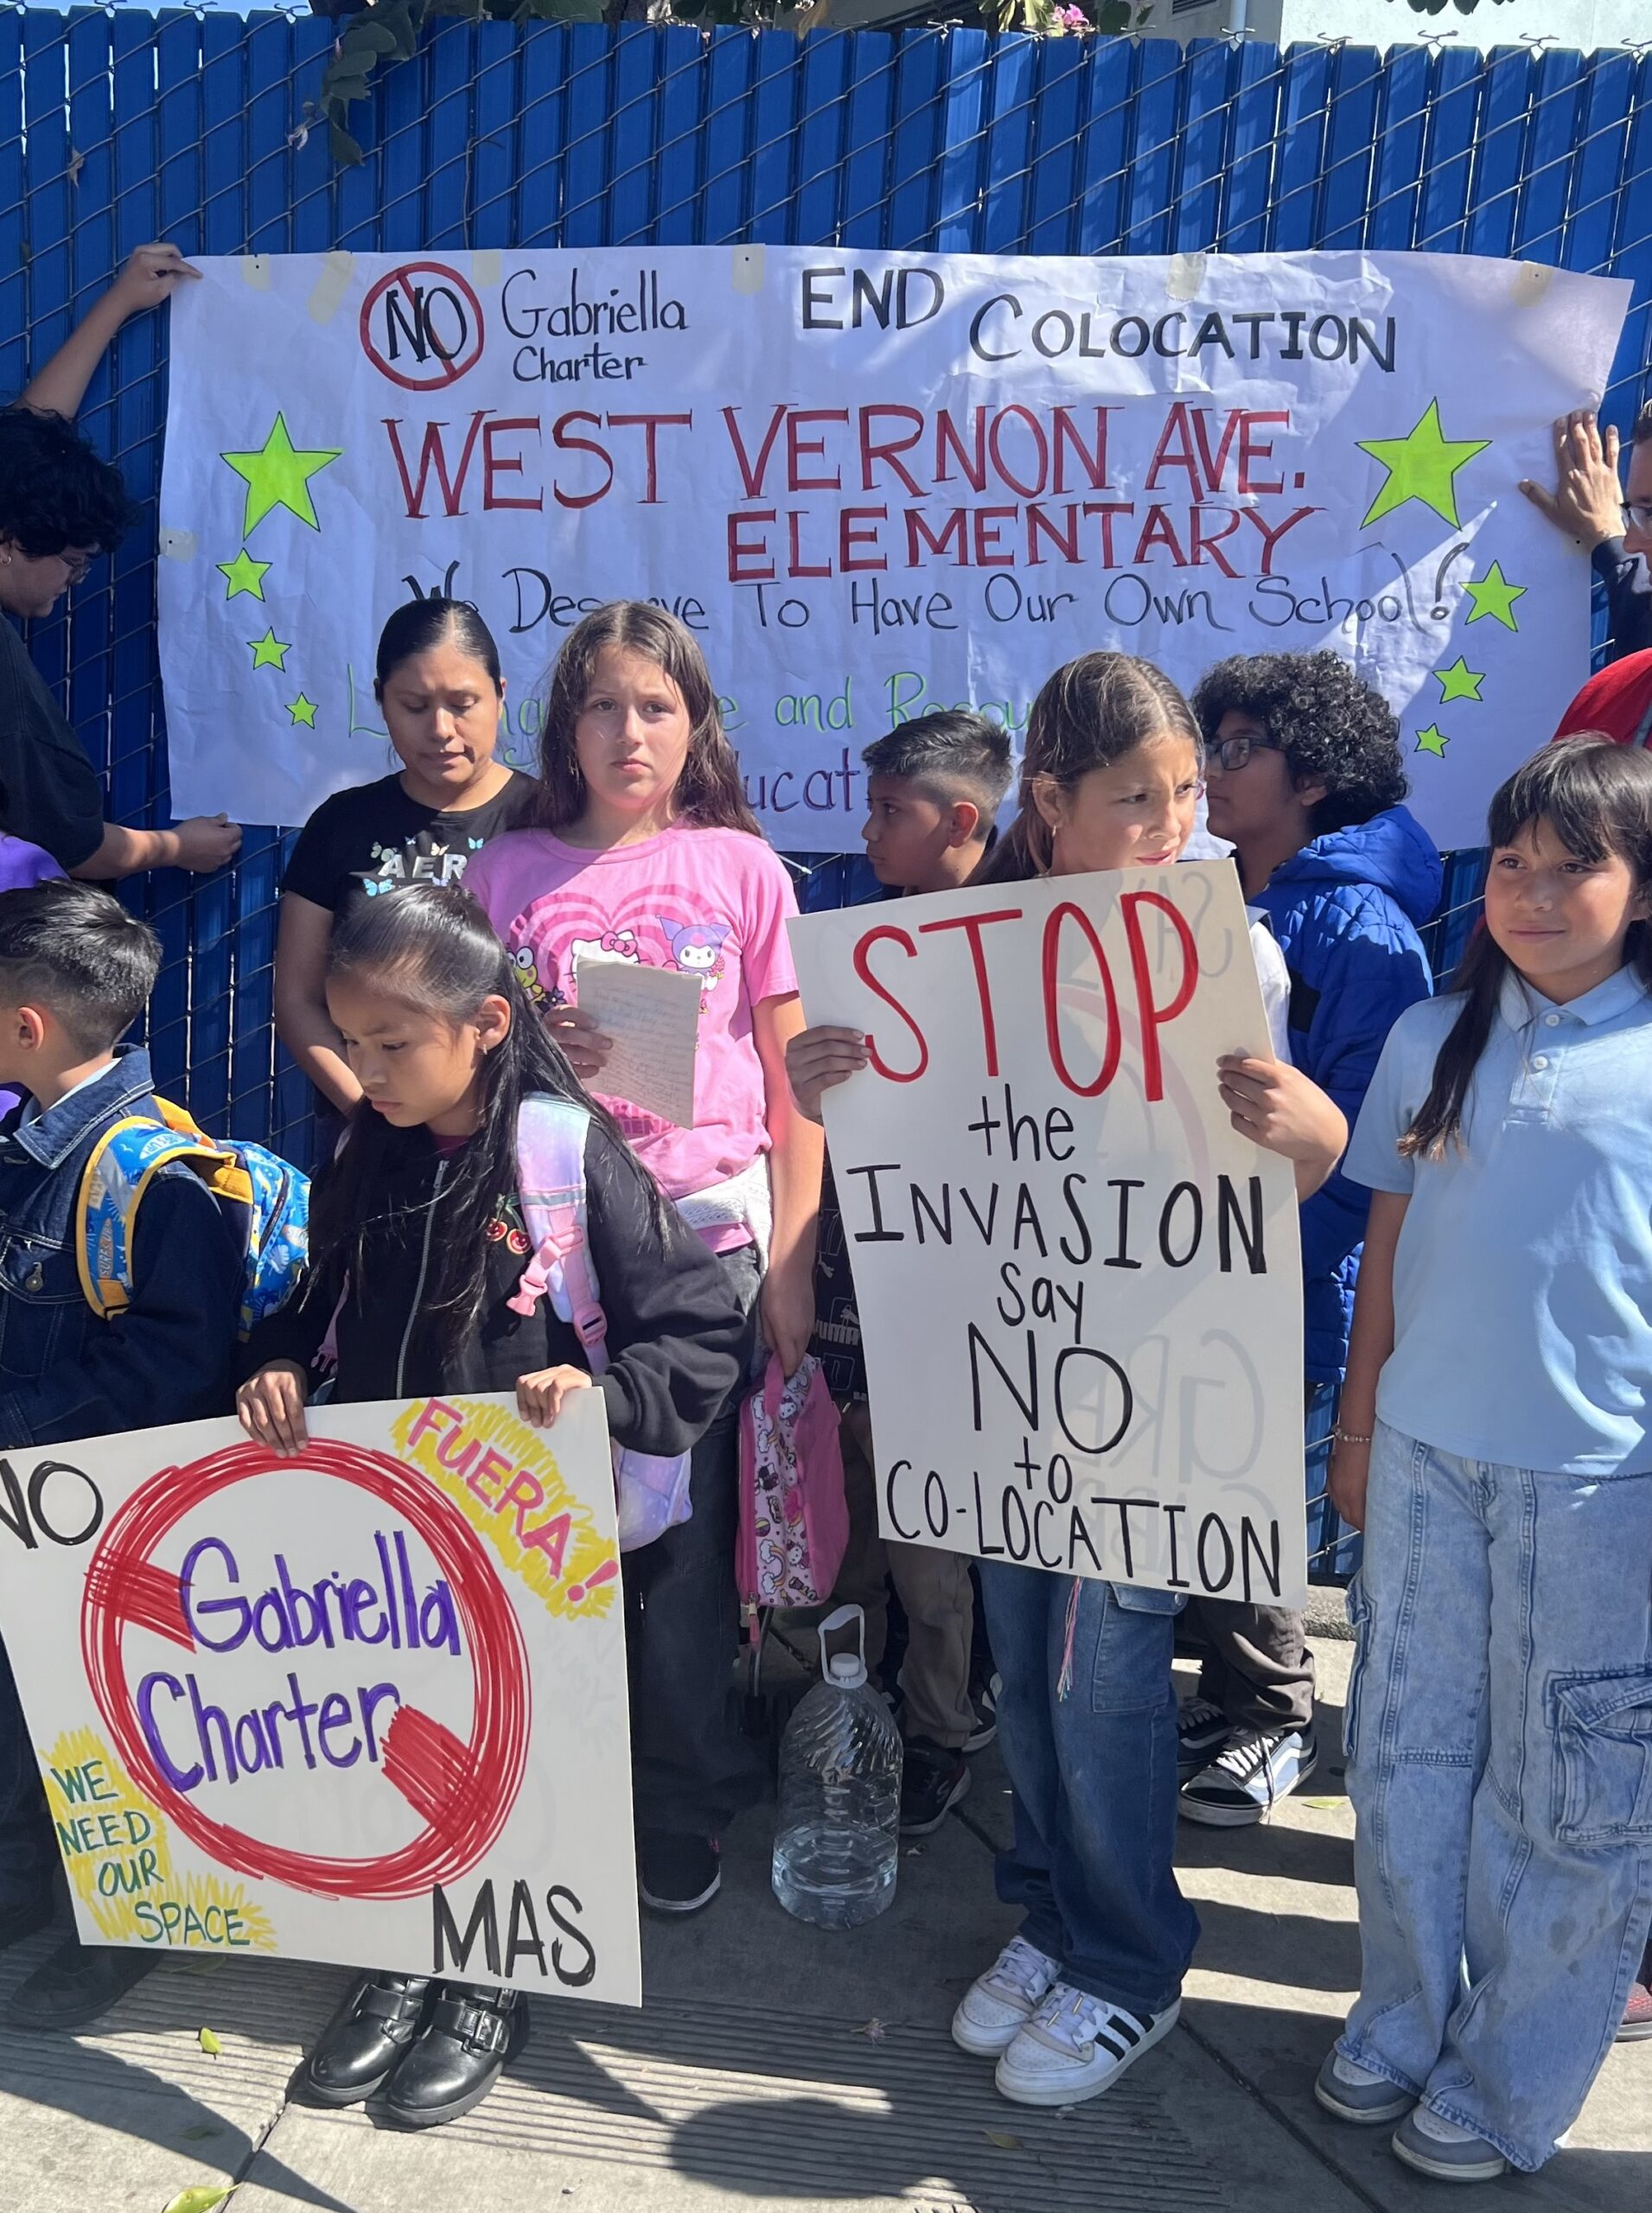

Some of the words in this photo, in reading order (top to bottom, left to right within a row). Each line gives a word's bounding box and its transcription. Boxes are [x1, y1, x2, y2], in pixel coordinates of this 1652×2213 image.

[386, 287, 468, 362] NO
[502, 270, 689, 338] Gabriella
[803, 267, 943, 330] END
[969, 294, 1397, 373] COLOCATION
[514, 347, 647, 382] Charter
[381, 410, 692, 518] WEST
[723, 404, 1125, 500] VERNON
[1145, 401, 1305, 502] AVE.
[727, 502, 1326, 581] ELEMENTARY
[736, 582, 810, 629] To
[851, 577, 959, 635] Have
[985, 572, 1075, 625] Our
[1105, 574, 1236, 633] Own
[775, 677, 855, 732] and
[853, 891, 1199, 1101] STOP
[968, 1083, 1075, 1162] the
[846, 1164, 1266, 1274] INVASION
[998, 1262, 1083, 1344] Say
[968, 1323, 1133, 1453] NO
[408, 1397, 619, 1602] FUERA!
[1014, 1437, 1072, 1503] to
[886, 1460, 1281, 1601] CO-LOCATION
[181, 1530, 461, 1655] Gabriella
[138, 1672, 399, 1793] Charter
[50, 1761, 118, 1804] WE
[58, 1810, 150, 1856] NEED
[98, 1850, 164, 1897] OUR
[135, 1902, 252, 1947] SPACE
[432, 1878, 596, 1987] MAS
